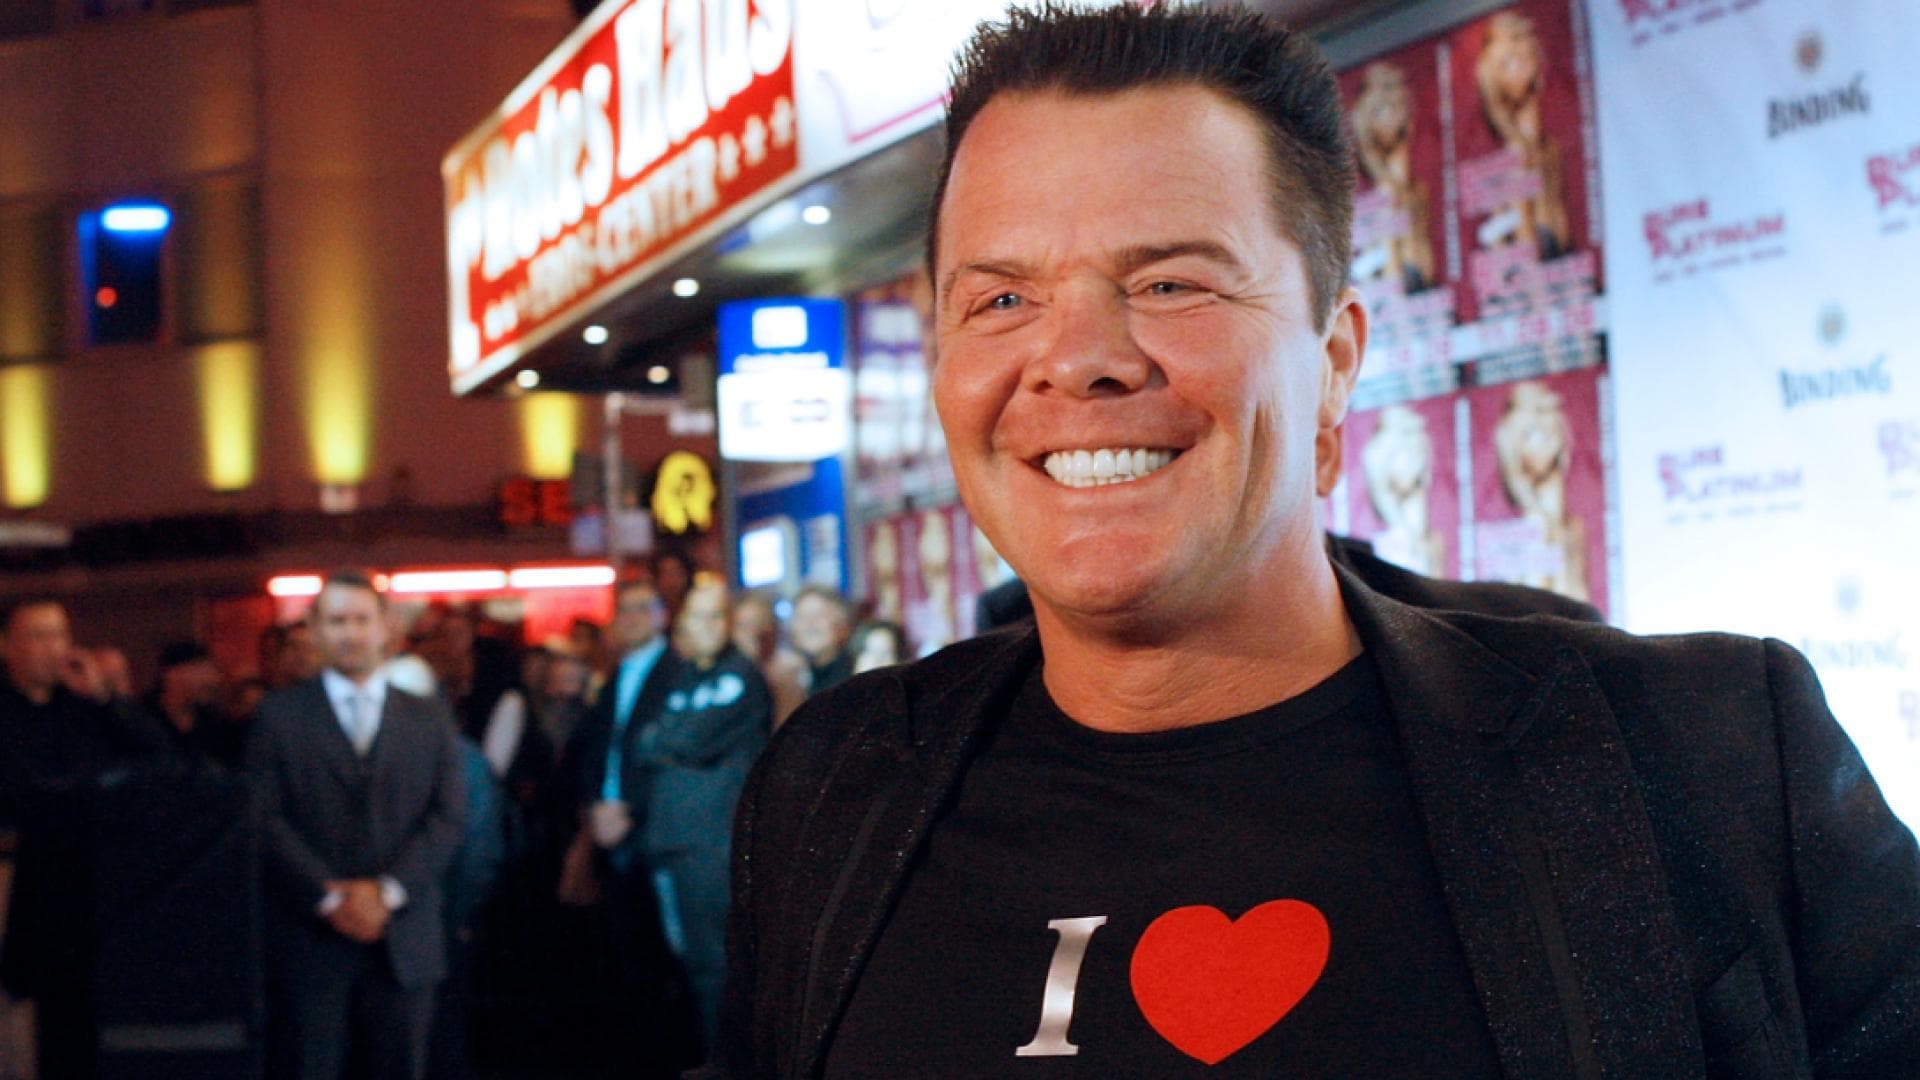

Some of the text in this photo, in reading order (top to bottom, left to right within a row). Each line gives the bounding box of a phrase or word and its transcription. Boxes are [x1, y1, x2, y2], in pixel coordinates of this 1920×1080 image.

[1766, 71, 1870, 139] BINDING
[1778, 353, 1891, 409] BINDING
[1015, 915, 1109, 1056] I
